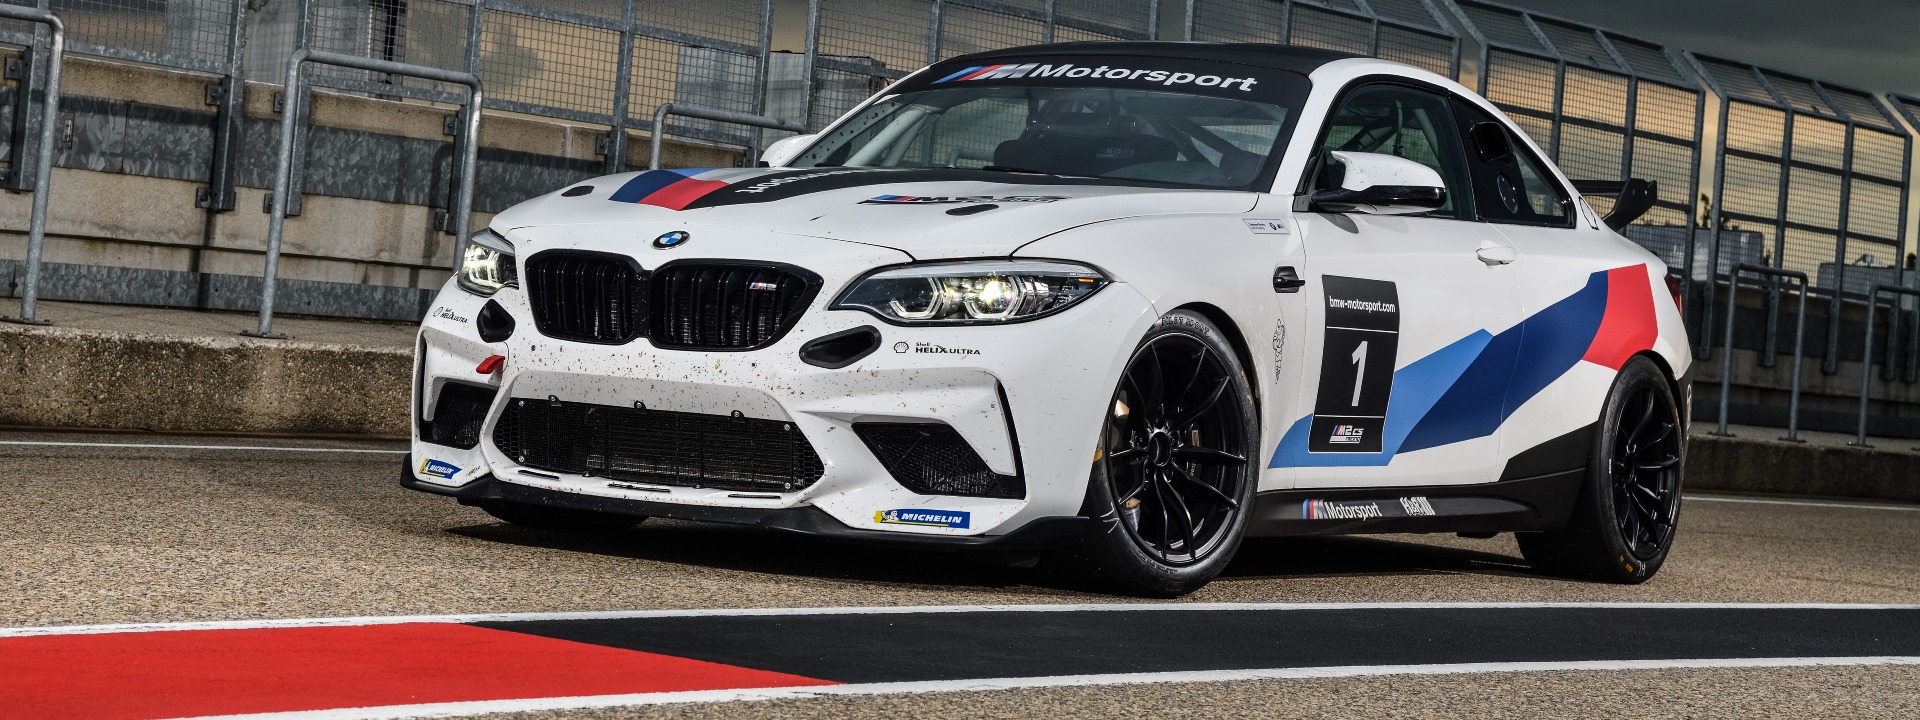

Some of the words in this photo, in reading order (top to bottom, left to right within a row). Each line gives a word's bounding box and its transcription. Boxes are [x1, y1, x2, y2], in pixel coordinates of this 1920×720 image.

[1029, 63, 1258, 92] Motorsport
[1329, 295, 1396, 313] bmw-motorsport.com
[915, 345, 948, 354] HELIX
[949, 348, 981, 356] ULTRA
[1351, 340, 1368, 407] 1
[901, 513, 962, 524] MICHELIN
[1324, 501, 1383, 521] Motorsport
